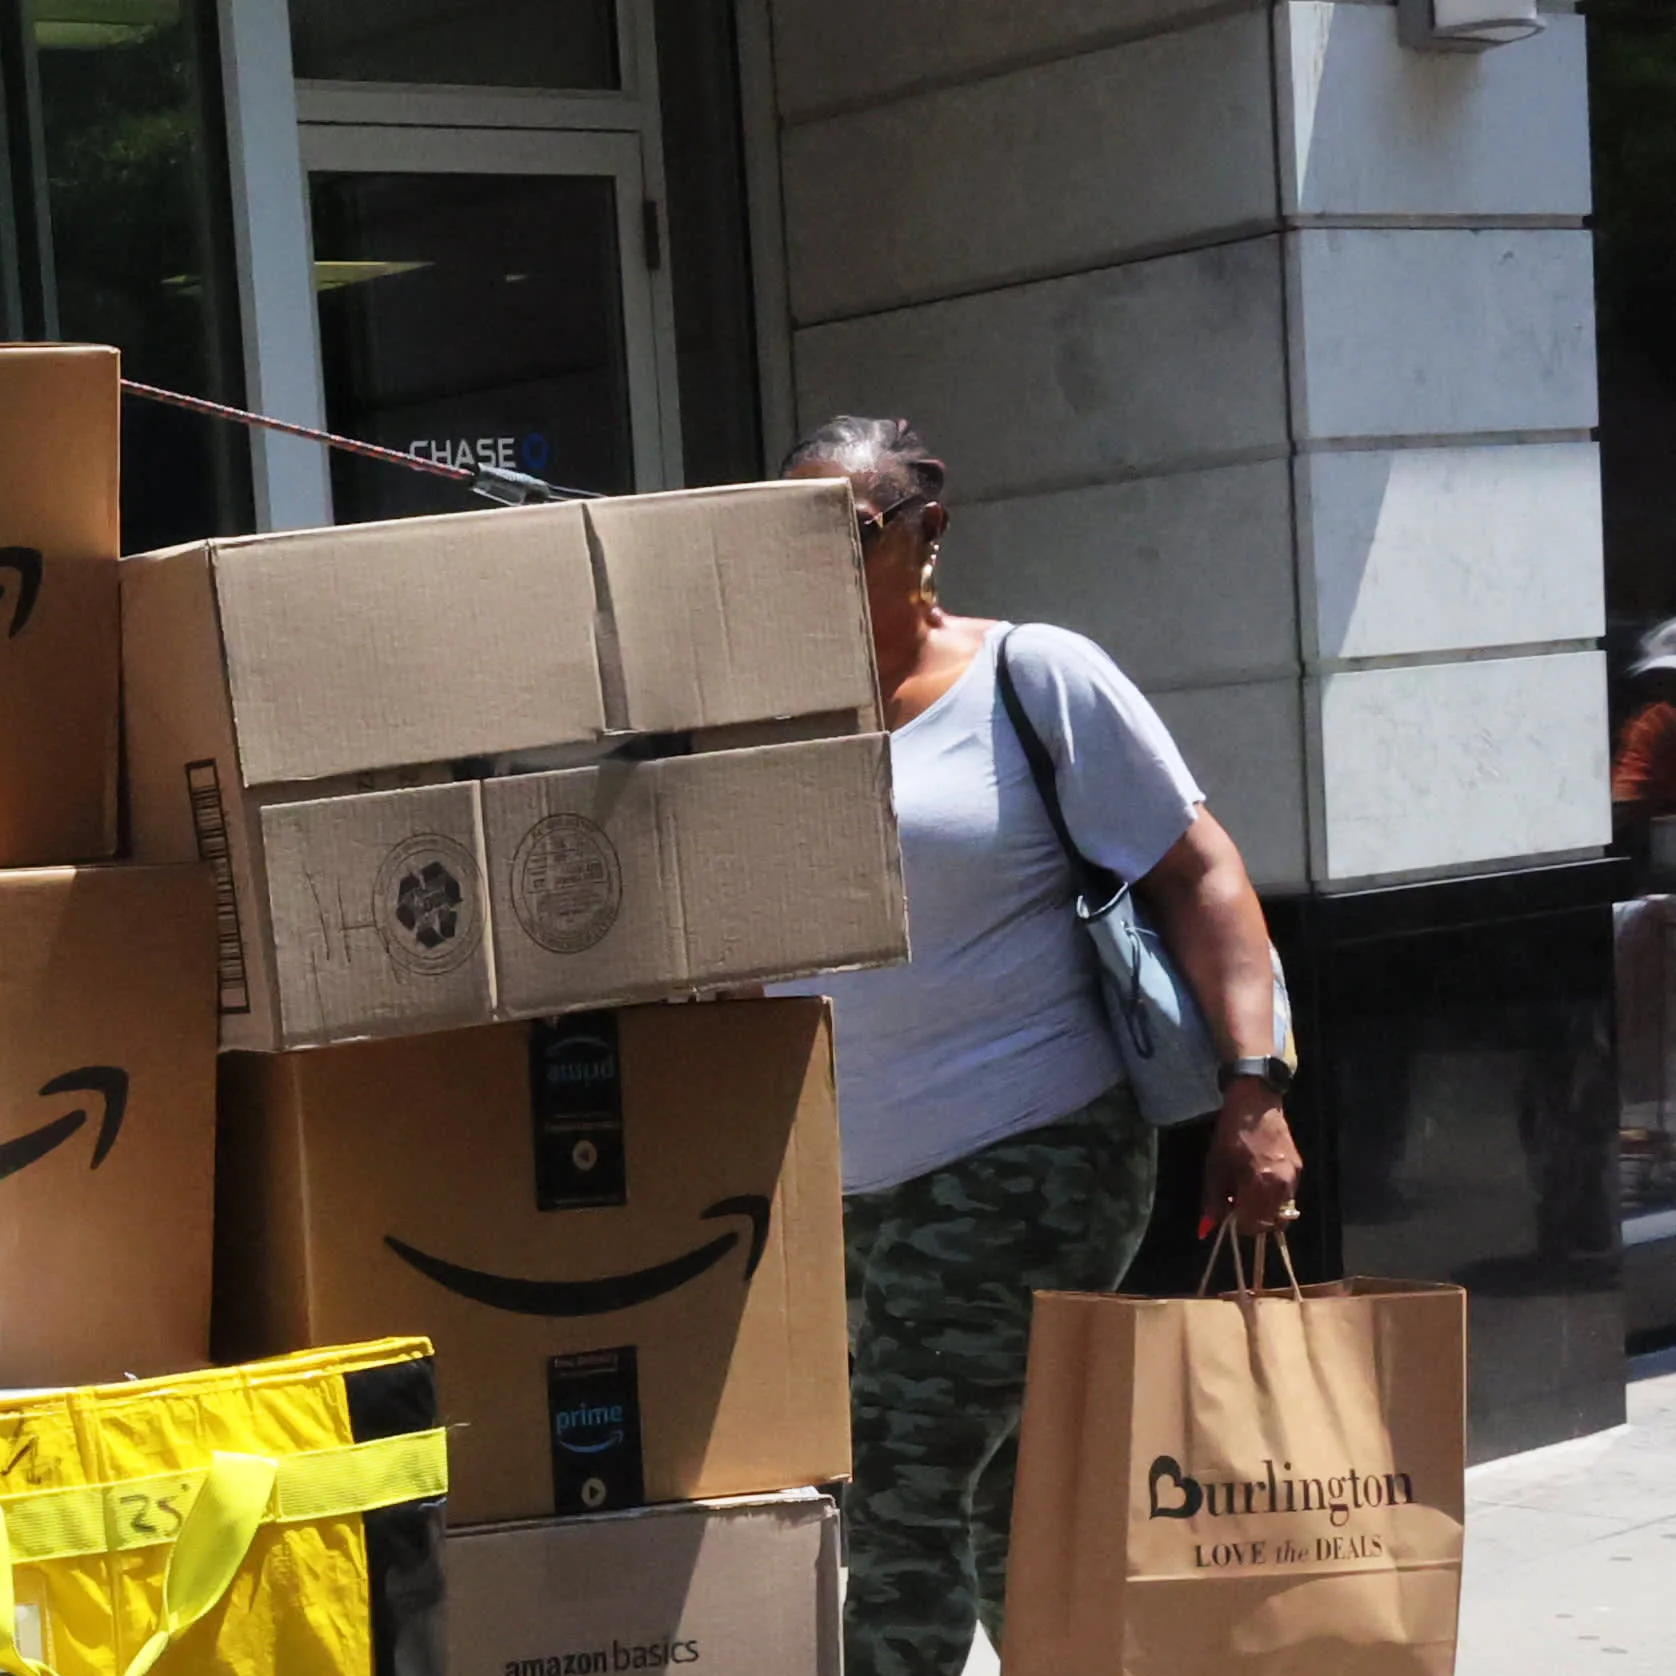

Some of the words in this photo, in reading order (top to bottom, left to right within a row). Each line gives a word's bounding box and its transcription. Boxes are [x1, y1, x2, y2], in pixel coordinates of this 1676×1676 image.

[408, 437, 517, 469] CHASE
[555, 1402, 625, 1435] prime
[1148, 1455, 1415, 1527] Burlington
[1194, 1541, 1268, 1568] LOVE
[1274, 1540, 1310, 1566] the
[1314, 1534, 1385, 1563] DEALS
